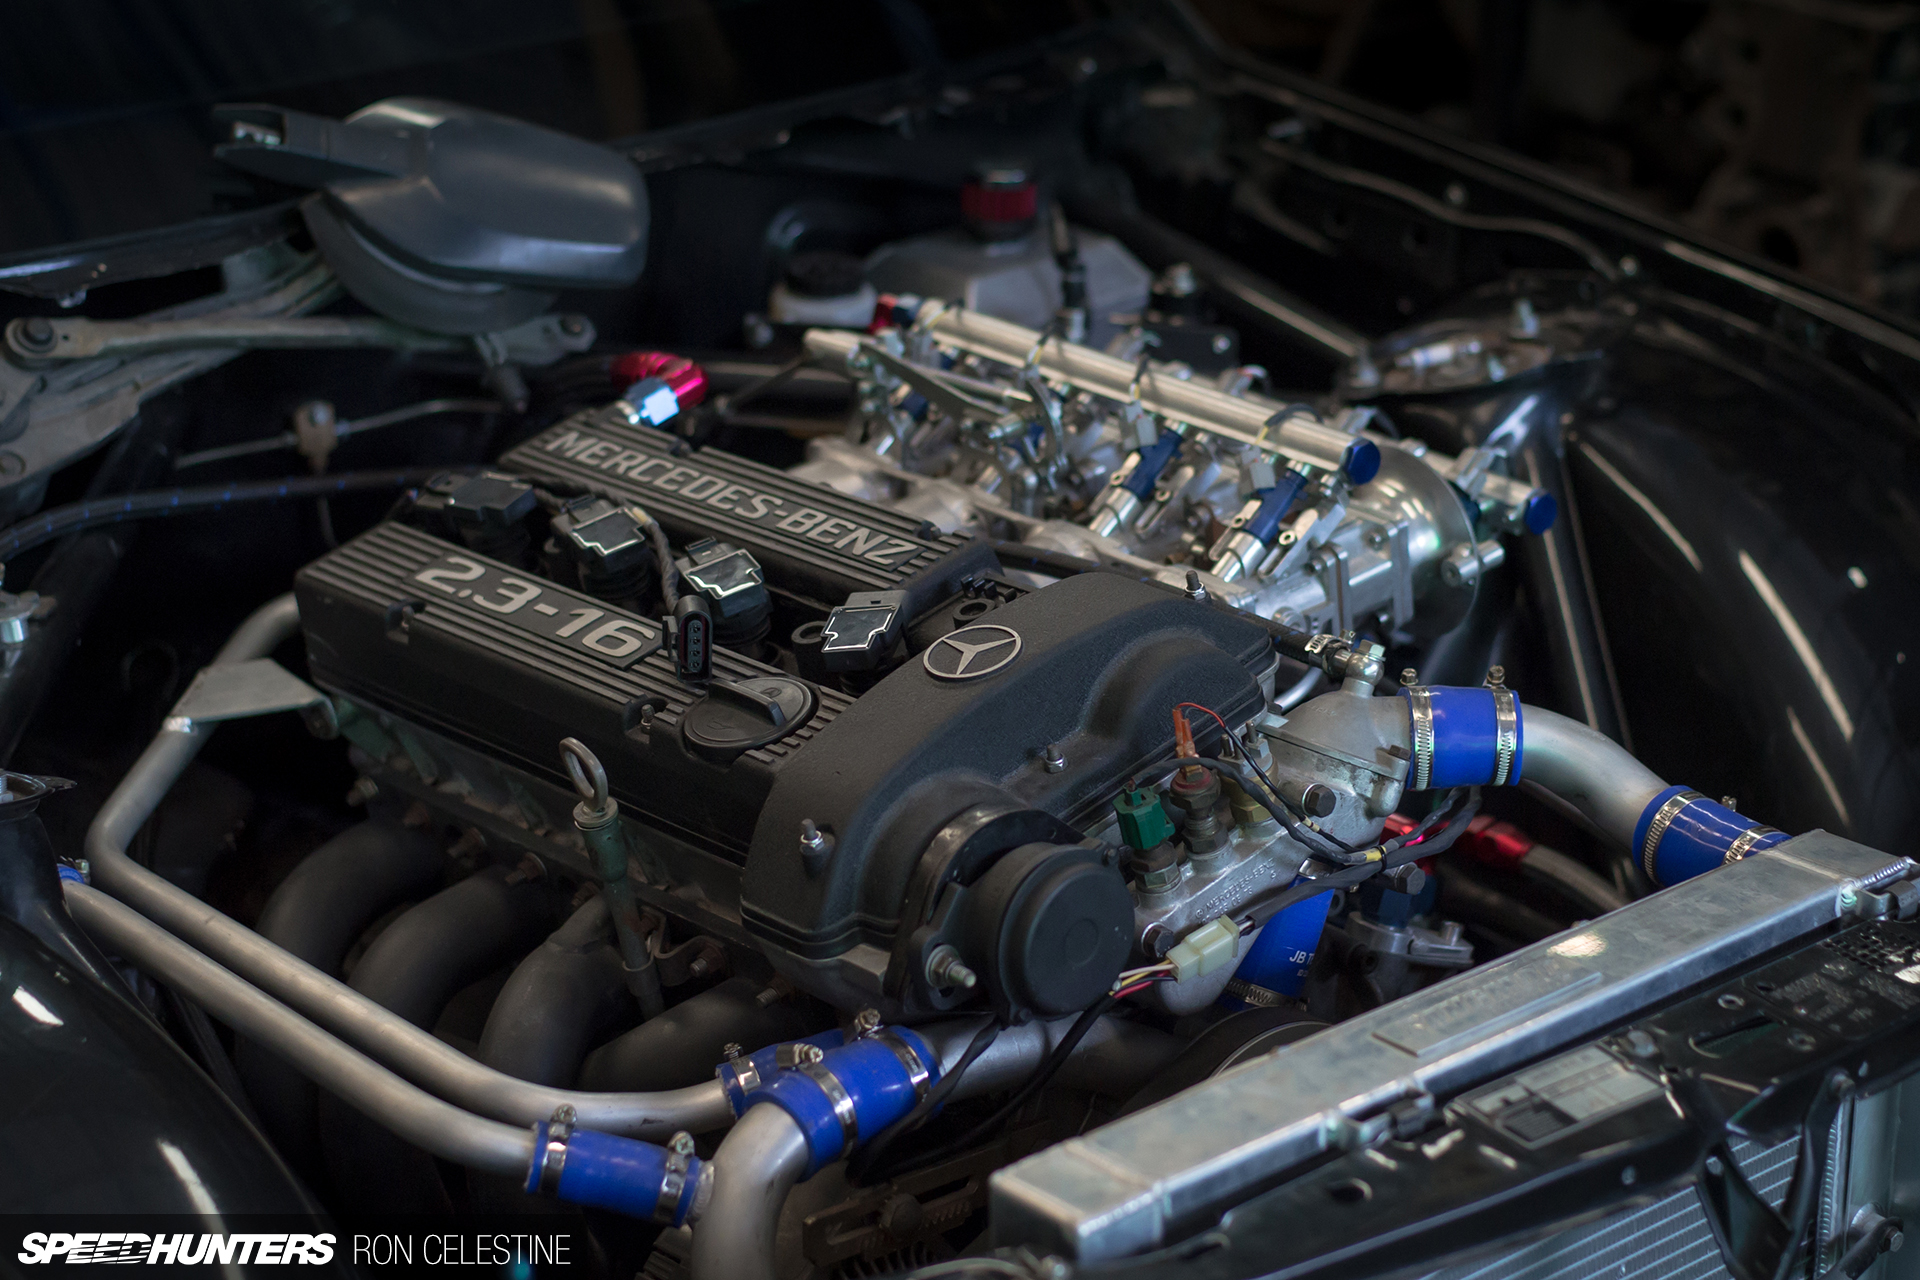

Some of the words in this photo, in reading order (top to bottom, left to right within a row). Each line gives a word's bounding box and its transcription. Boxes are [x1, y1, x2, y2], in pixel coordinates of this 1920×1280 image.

[546, 431, 918, 567] MERCEDES-BENZ
[416, 557, 656, 657] 2.3-16
[1289, 950, 1307, 964] JB
